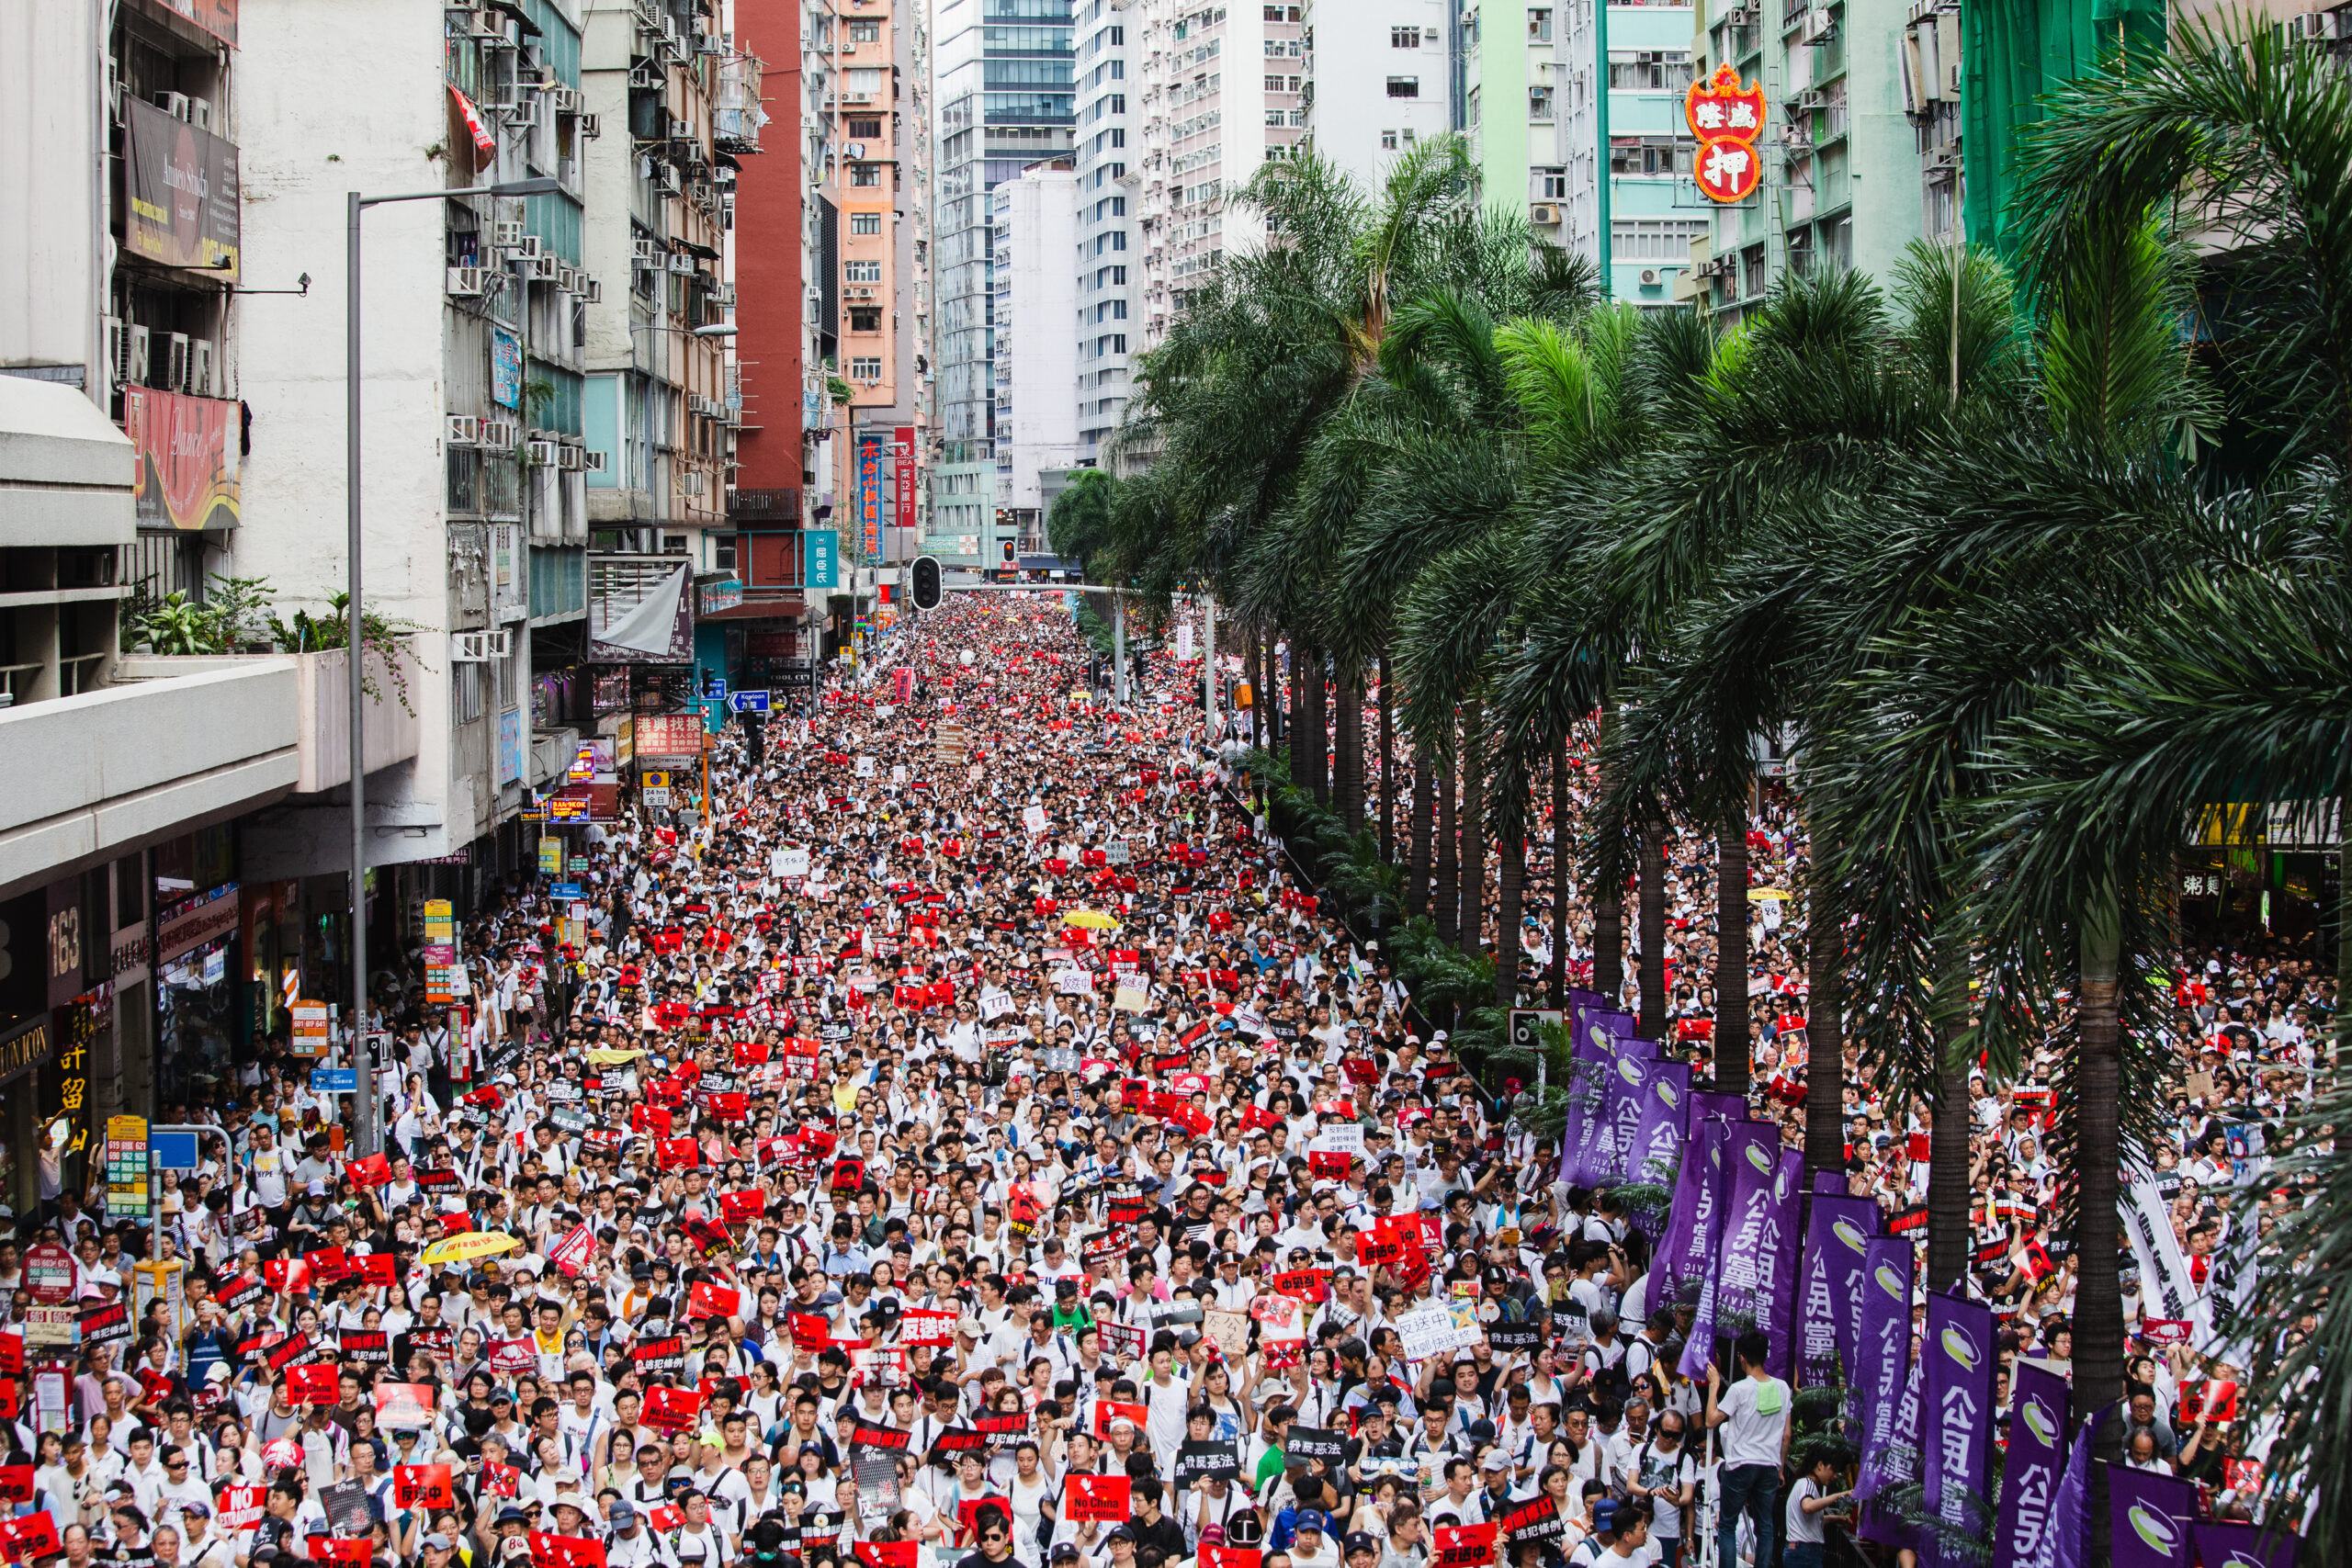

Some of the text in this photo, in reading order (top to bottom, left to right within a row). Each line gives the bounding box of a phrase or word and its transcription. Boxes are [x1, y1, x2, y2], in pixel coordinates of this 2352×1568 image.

[163, 152, 187, 191] Amico
[1703, 144, 1749, 195] 押
[816, 547, 828, 583] 屈臣氏
[637, 716, 701, 732] 港興找換
[648, 796, 664, 805] 全日
[2183, 874, 2221, 897] 粥麵
[49, 906, 80, 978] 163
[1062, 975, 1091, 991] 反送中
[22, 1024, 47, 1062] ICON
[135, 1141, 146, 1151] 621
[582, 1127, 622, 1146] 反送中
[1315, 1165, 1344, 1177] 反送中
[1083, 1230, 1127, 1256] 反送中
[1365, 1243, 1397, 1261] 反送中
[696, 1299, 729, 1314] No China
[30, 1311, 44, 1322] 603
[1398, 1312, 1447, 1337] 反送中
[901, 1315, 957, 1341] 反送中
[409, 1330, 453, 1349] 反送中
[645, 1358, 684, 1371] 逃犯條例
[293, 1383, 332, 1394] No China
[650, 1405, 687, 1420] No China
[230, 1487, 254, 1511] NO
[401, 1483, 443, 1503] 反送中
[1074, 1496, 1119, 1508] No China
[1516, 1518, 1562, 1541] 逃犯條例
[1442, 1544, 1487, 1564] 反送中
